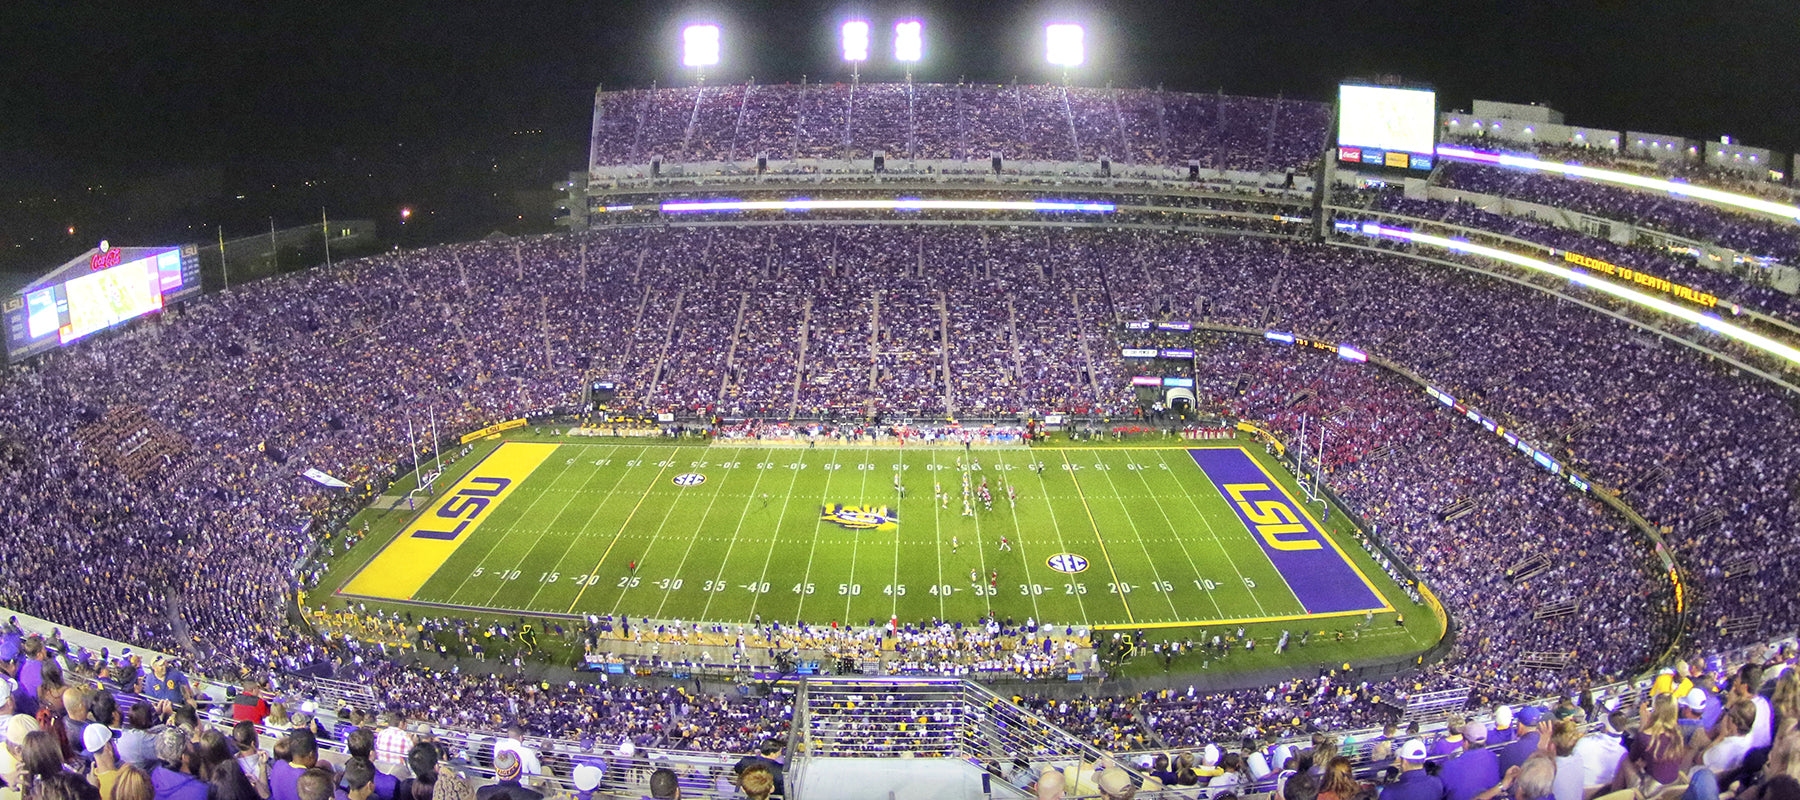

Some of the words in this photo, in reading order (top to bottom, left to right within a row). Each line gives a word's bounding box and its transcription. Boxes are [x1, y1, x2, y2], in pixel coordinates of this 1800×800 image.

[1565, 252, 1616, 275] WELCOME
[1618, 267, 1633, 280] TO
[1634, 272, 1671, 293] DEATH
[1674, 284, 1718, 308] VALLEY
[3, 297, 24, 313] LSU
[673, 473, 706, 486] SEC
[411, 477, 512, 540] LSU
[1222, 483, 1323, 551] LSU
[1048, 554, 1087, 572] SEC
[472, 567, 485, 577] 5
[500, 569, 521, 580] 10
[539, 572, 560, 583] 15
[576, 574, 600, 586] 20
[617, 576, 641, 588] 25
[660, 578, 684, 590] 30
[703, 580, 727, 592] 35
[747, 582, 771, 593] 40
[792, 583, 815, 594] 45
[838, 584, 861, 595] 50
[883, 584, 906, 596] 45
[929, 584, 952, 596] 40
[975, 584, 997, 596] 35
[1019, 584, 1043, 596] 30
[1064, 583, 1088, 595] 25
[1107, 582, 1131, 594] 20
[1152, 580, 1174, 592] 15
[1193, 579, 1216, 590] 10
[1243, 577, 1256, 588] 5
